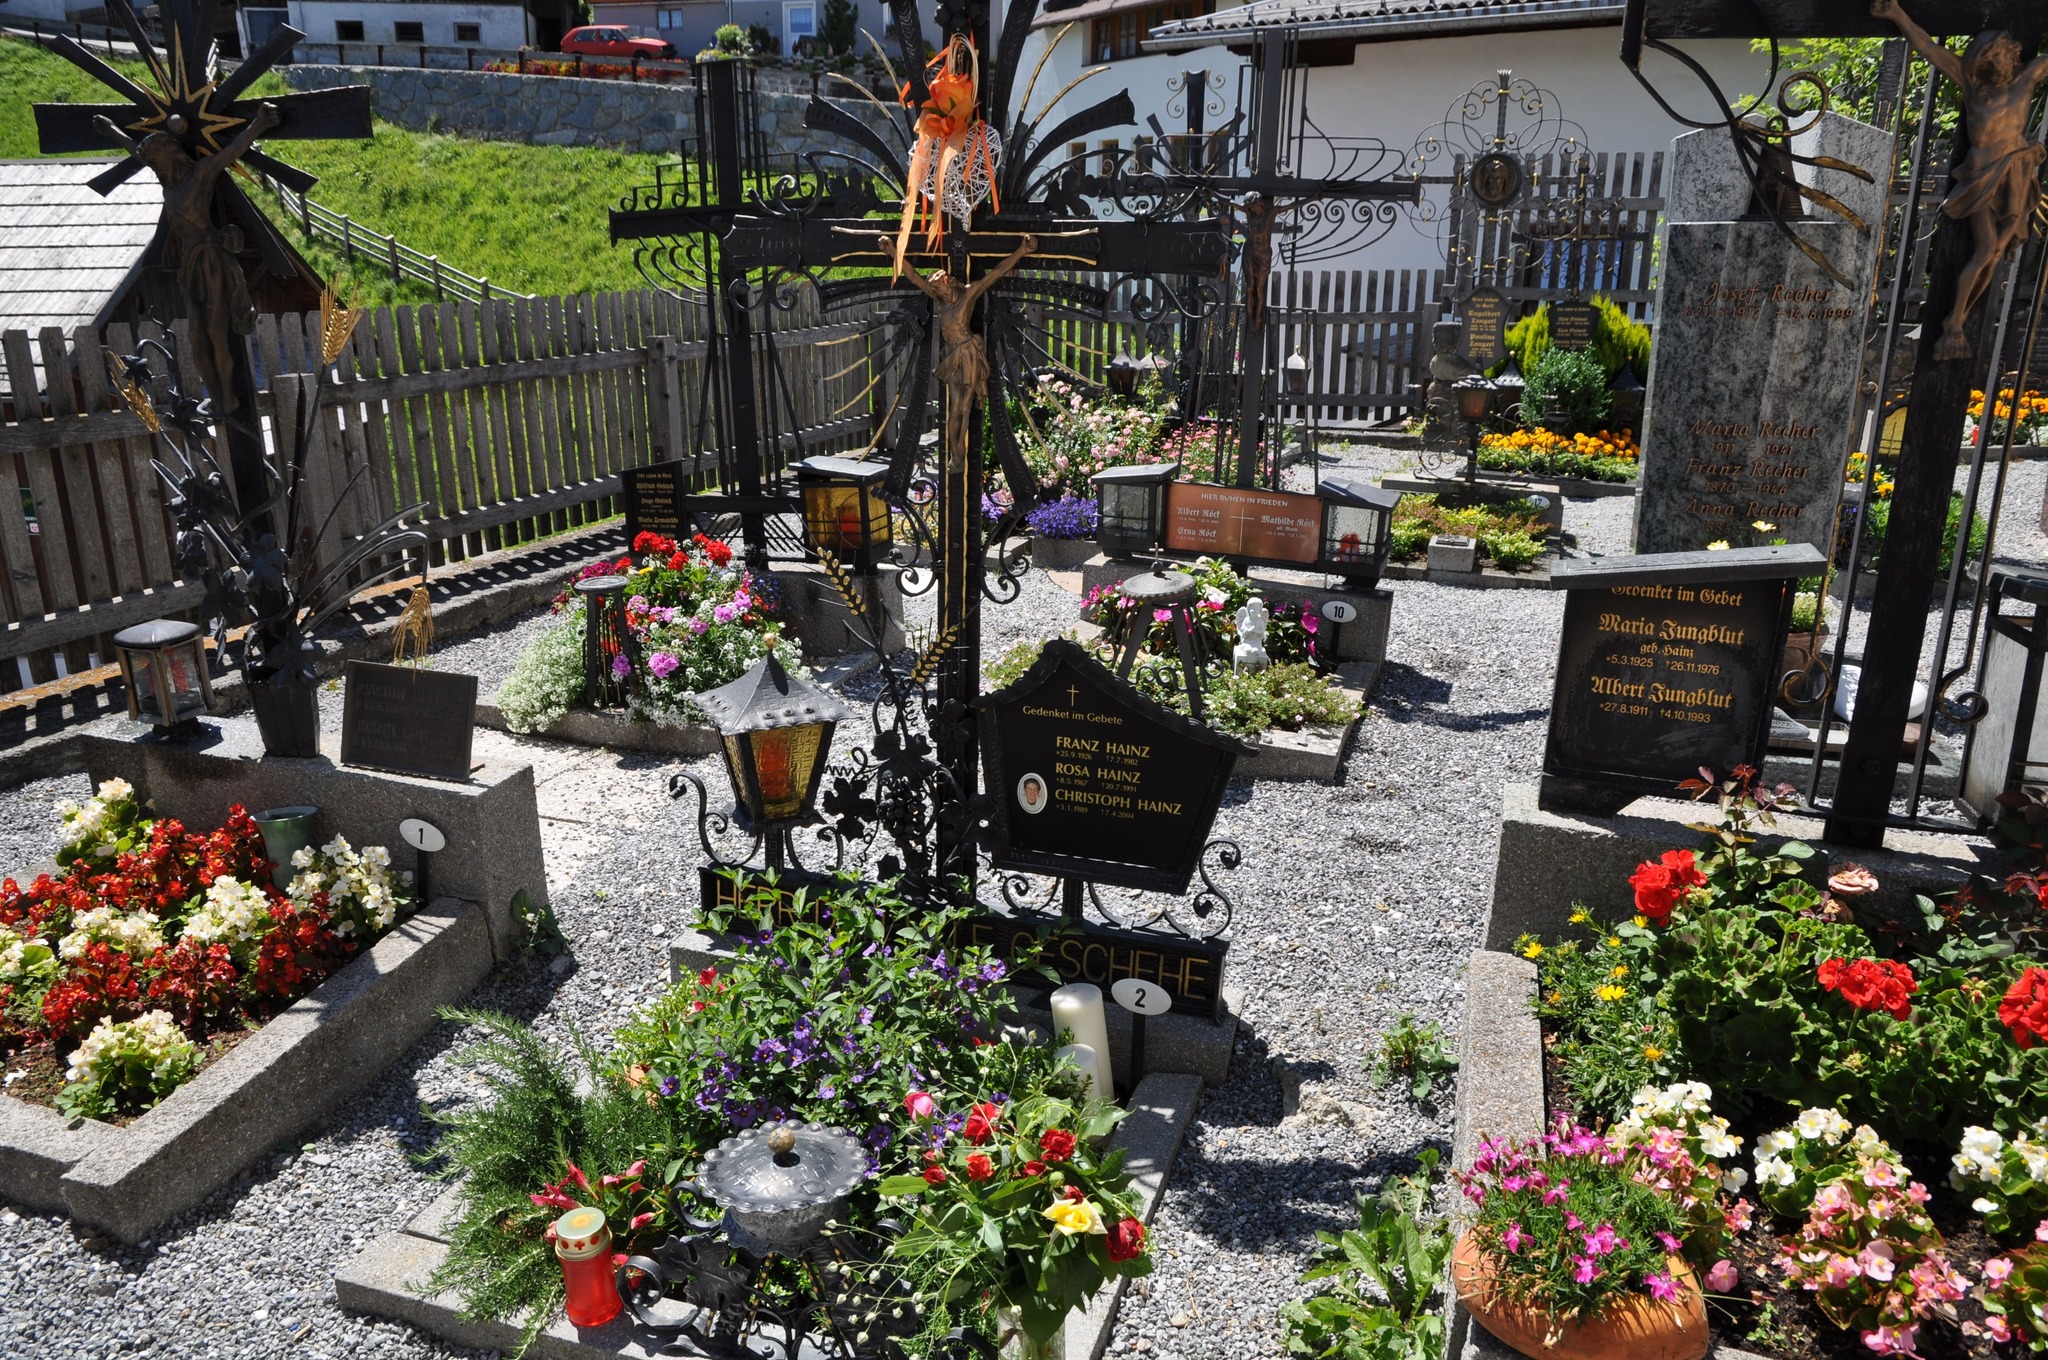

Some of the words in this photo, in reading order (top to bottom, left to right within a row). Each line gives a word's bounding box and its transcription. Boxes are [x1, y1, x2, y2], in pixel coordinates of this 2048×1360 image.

[1704, 283, 1760, 305] Josef
[1772, 284, 1834, 302] Recher
[1689, 420, 1750, 437] Maria
[1760, 421, 1820, 438] Recher
[1711, 443, 1736, 453] 1911
[1766, 444, 1794, 456] 1941
[1686, 458, 1742, 476] Franz
[1752, 460, 1810, 478] Recher
[1706, 482, 1736, 492] 1870
[1756, 484, 1788, 496] 1946
[1177, 506, 1200, 516] Albert
[1257, 498, 1288, 507] FRIEDEN
[1683, 498, 1735, 516] Anna
[1746, 500, 1805, 518] Recher
[1261, 514, 1294, 526] Mathilde
[1178, 526, 1196, 536] Erna
[1678, 586, 1695, 602] im
[1699, 588, 1743, 607] Gebet
[1334, 605, 1344, 618] 10
[1598, 613, 1655, 636] Maria
[1659, 619, 1744, 646] Jungblut
[1591, 675, 1645, 698] Albert
[1648, 682, 1733, 709] Jungblut
[1023, 706, 1069, 720] Gedenket
[1072, 711, 1084, 720] im
[1087, 712, 1123, 725] Gebete
[1056, 736, 1100, 752] FRANZ
[1106, 742, 1150, 758] HAINZ
[1056, 762, 1090, 777] ROSA
[1098, 768, 1141, 784] HAINZ
[1055, 788, 1130, 809] CHRISTOPH
[1138, 799, 1182, 815] HAINZ
[418, 828, 424, 844] 1
[1135, 988, 1146, 1008] 2
